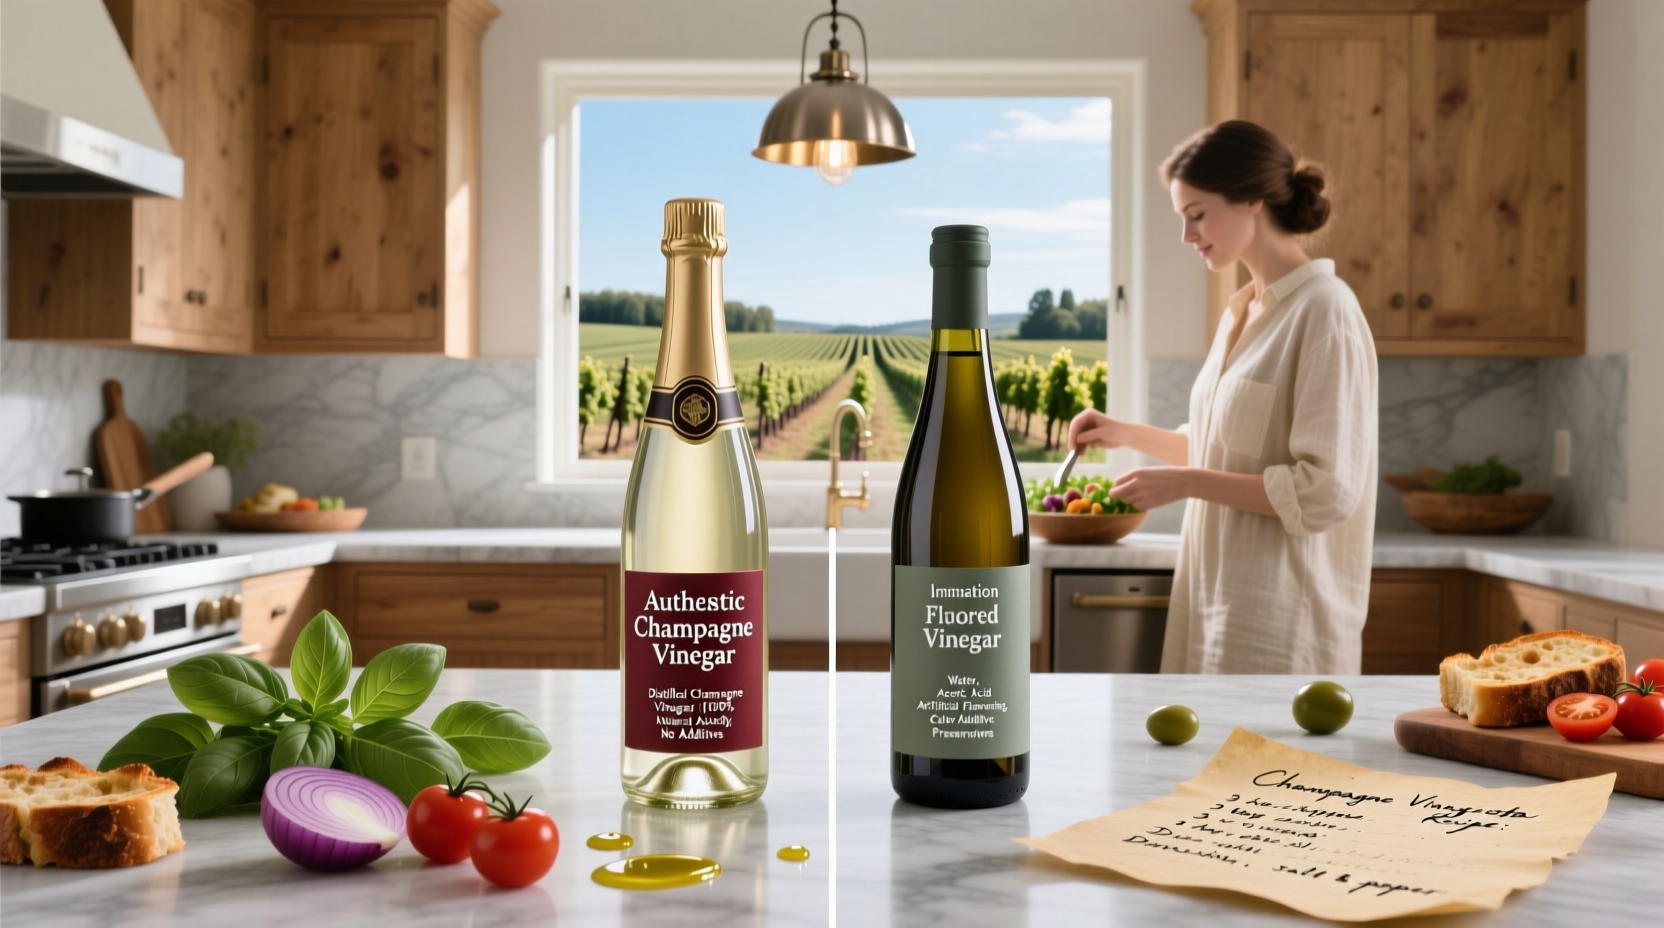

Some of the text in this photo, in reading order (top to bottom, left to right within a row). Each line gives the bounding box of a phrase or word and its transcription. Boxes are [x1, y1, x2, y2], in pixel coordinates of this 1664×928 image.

[634, 615, 753, 644] Champagne
[922, 628, 1002, 654] Vinegar
[652, 643, 736, 672] Vinegar
[661, 726, 675, 739] No
